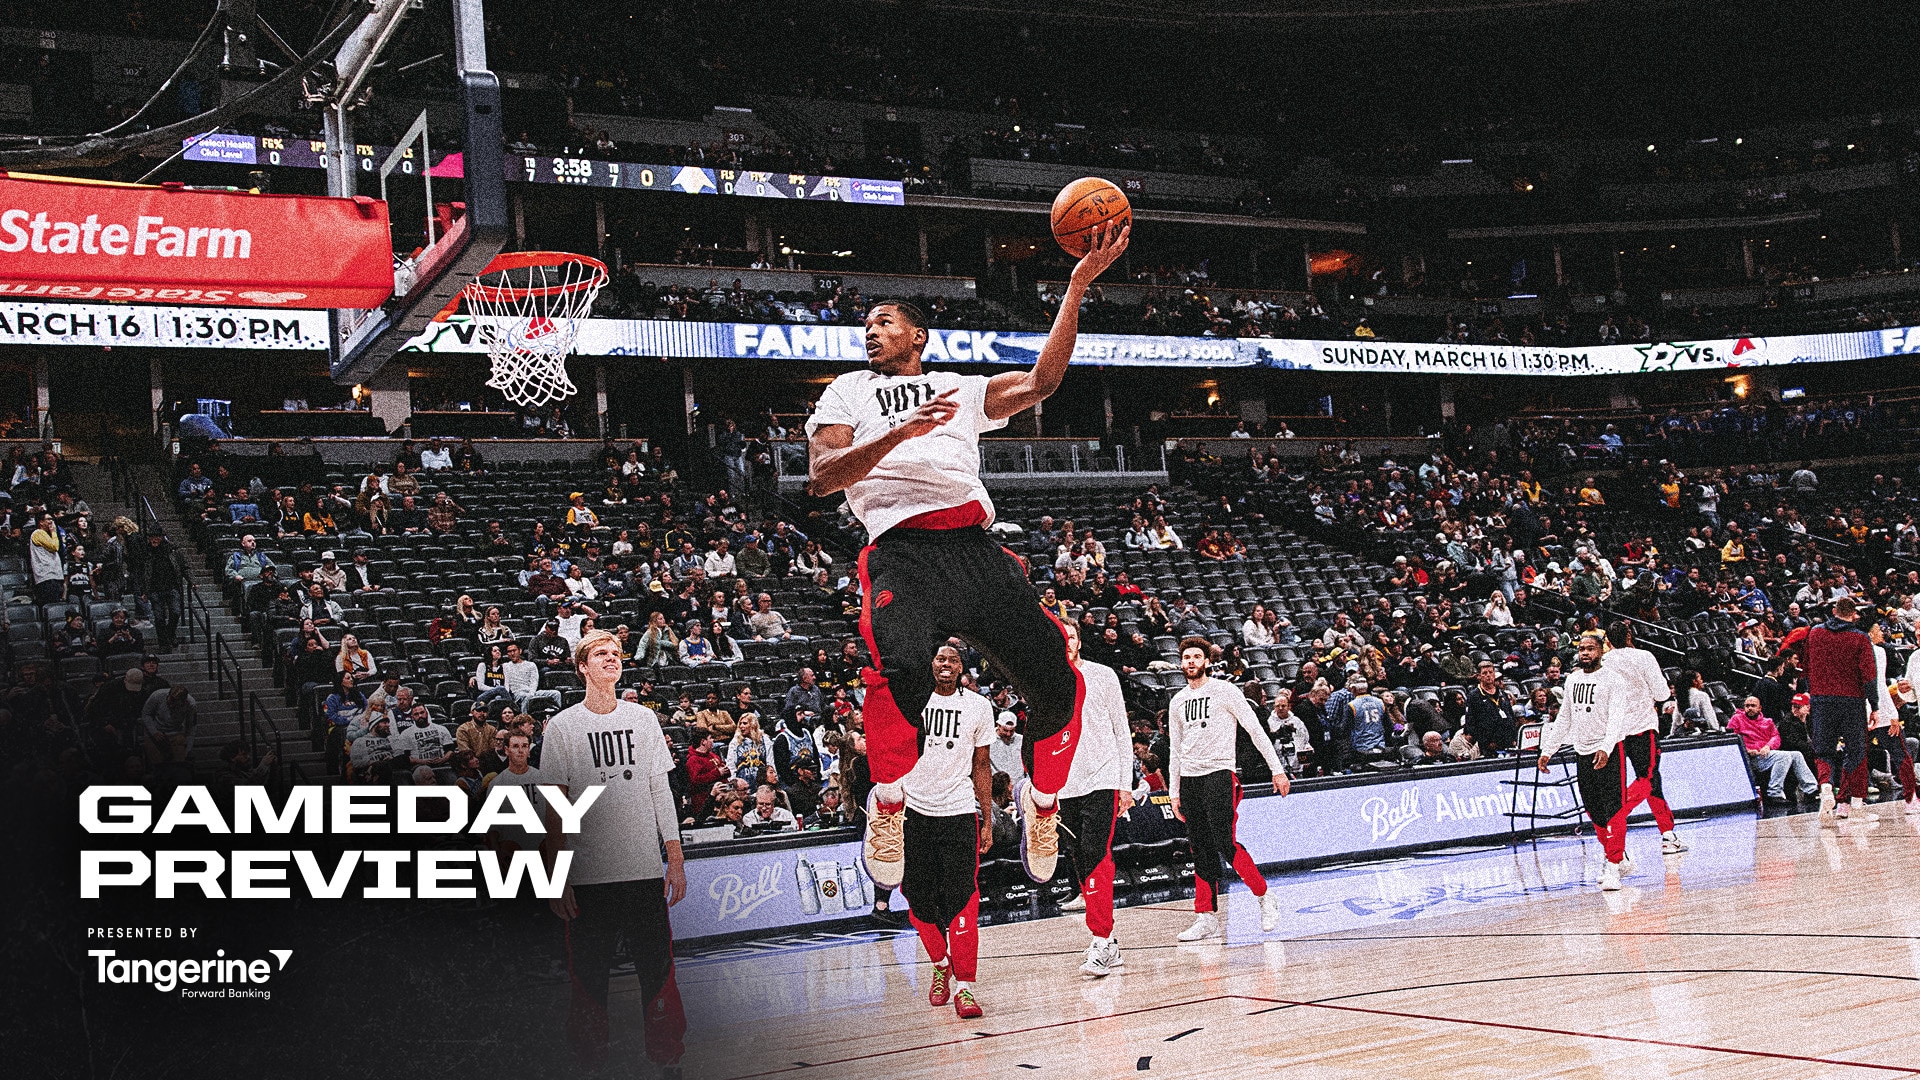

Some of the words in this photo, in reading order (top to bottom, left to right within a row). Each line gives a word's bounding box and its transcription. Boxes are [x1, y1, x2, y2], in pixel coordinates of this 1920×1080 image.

[269, 151, 280, 165] 0
[362, 158, 373, 171] 0
[402, 160, 413, 174] 0
[552, 158, 593, 177] 3:58
[526, 169, 535, 182] 7
[609, 174, 619, 187] 7
[640, 169, 654, 187] 0
[724, 181, 734, 195] 0
[795, 186, 805, 199] 0
[829, 188, 839, 201] 0
[108, 315, 141, 337] 16
[172, 316, 237, 339] 1:30
[734, 325, 867, 358] FAMIL
[922, 331, 1000, 361] ACK
[1190, 346, 1235, 361] SODA
[1415, 350, 1486, 368] MARCH
[1491, 353, 1507, 368] 16
[1521, 353, 1553, 369] 1:30
[1573, 682, 1597, 705] VOTE
[1185, 697, 1211, 722] VOTE
[1364, 708, 1380, 723] 15
[924, 707, 962, 739] VOTE
[587, 729, 636, 768] VOTE
[1160, 805, 1175, 820] 15
[1360, 785, 1423, 843] Ball
[708, 861, 784, 922] Ball
